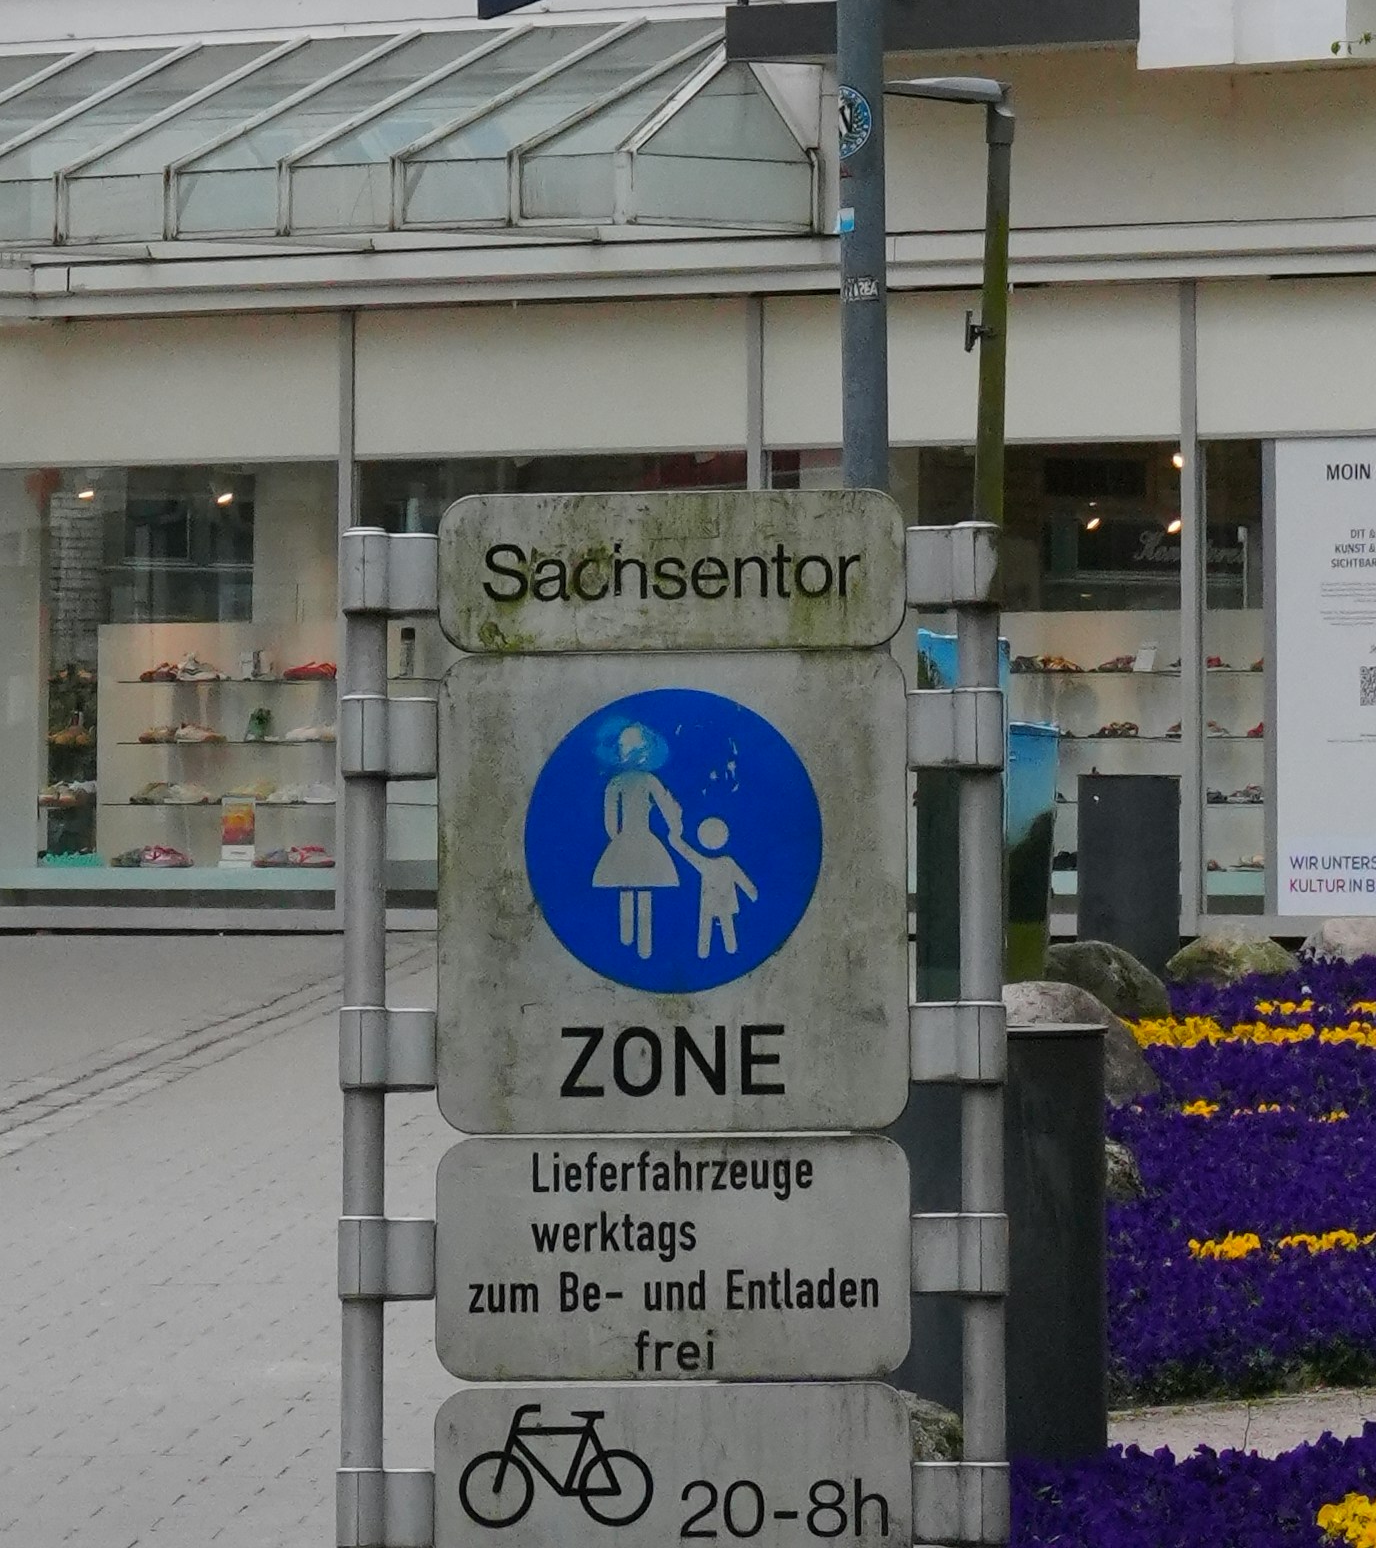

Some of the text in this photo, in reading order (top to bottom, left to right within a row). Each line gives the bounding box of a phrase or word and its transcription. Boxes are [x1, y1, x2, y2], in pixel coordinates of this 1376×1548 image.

[1326, 463, 1371, 481] MOIN
[1334, 543, 1366, 554] KUNST
[1350, 528, 1366, 539] DIT
[482, 542, 861, 603] Sachsentor
[1290, 855, 1319, 870] WIR
[1289, 878, 1345, 893] KULTUR
[1349, 879, 1363, 893] IN
[560, 1024, 785, 1098] ZONE
[531, 1149, 814, 1201] Lieferfahrzeuge
[531, 1210, 697, 1262] werktags
[468, 1267, 879, 1314] zum Be- und Entladen
[634, 1328, 715, 1372] frei
[680, 1477, 889, 1538] 20-8h
